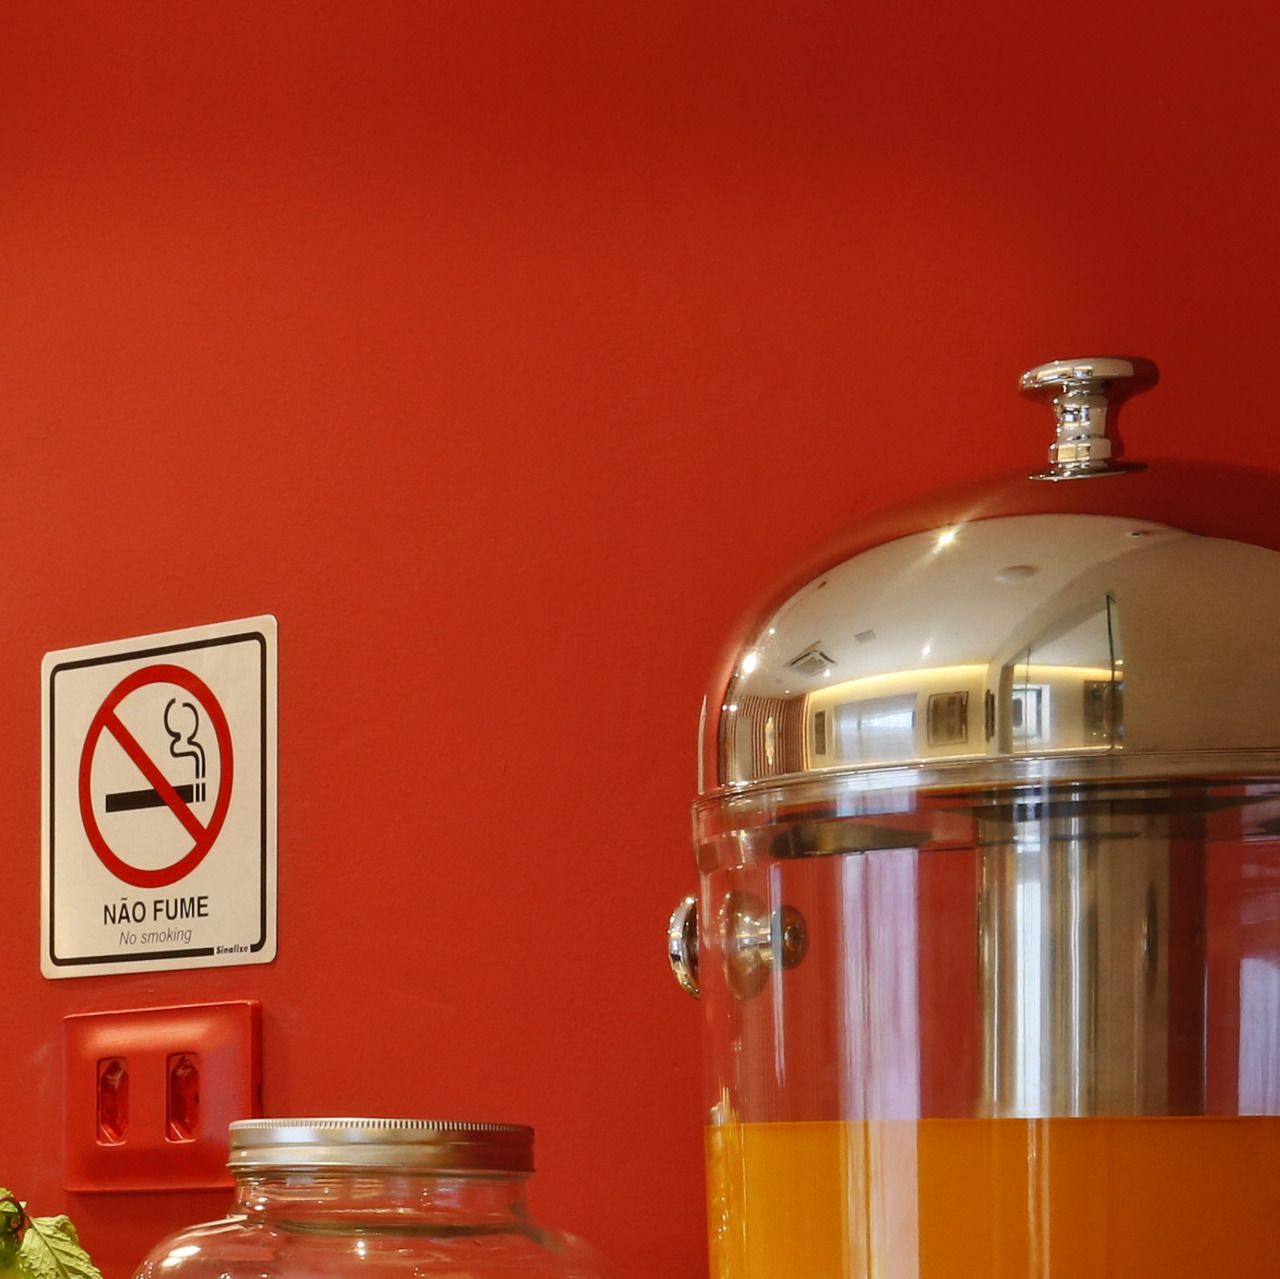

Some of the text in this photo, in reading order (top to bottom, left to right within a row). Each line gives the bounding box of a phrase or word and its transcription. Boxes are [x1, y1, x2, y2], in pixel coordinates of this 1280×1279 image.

[104, 896, 209, 925] NÃO FUME
[119, 927, 192, 945] No smoking
